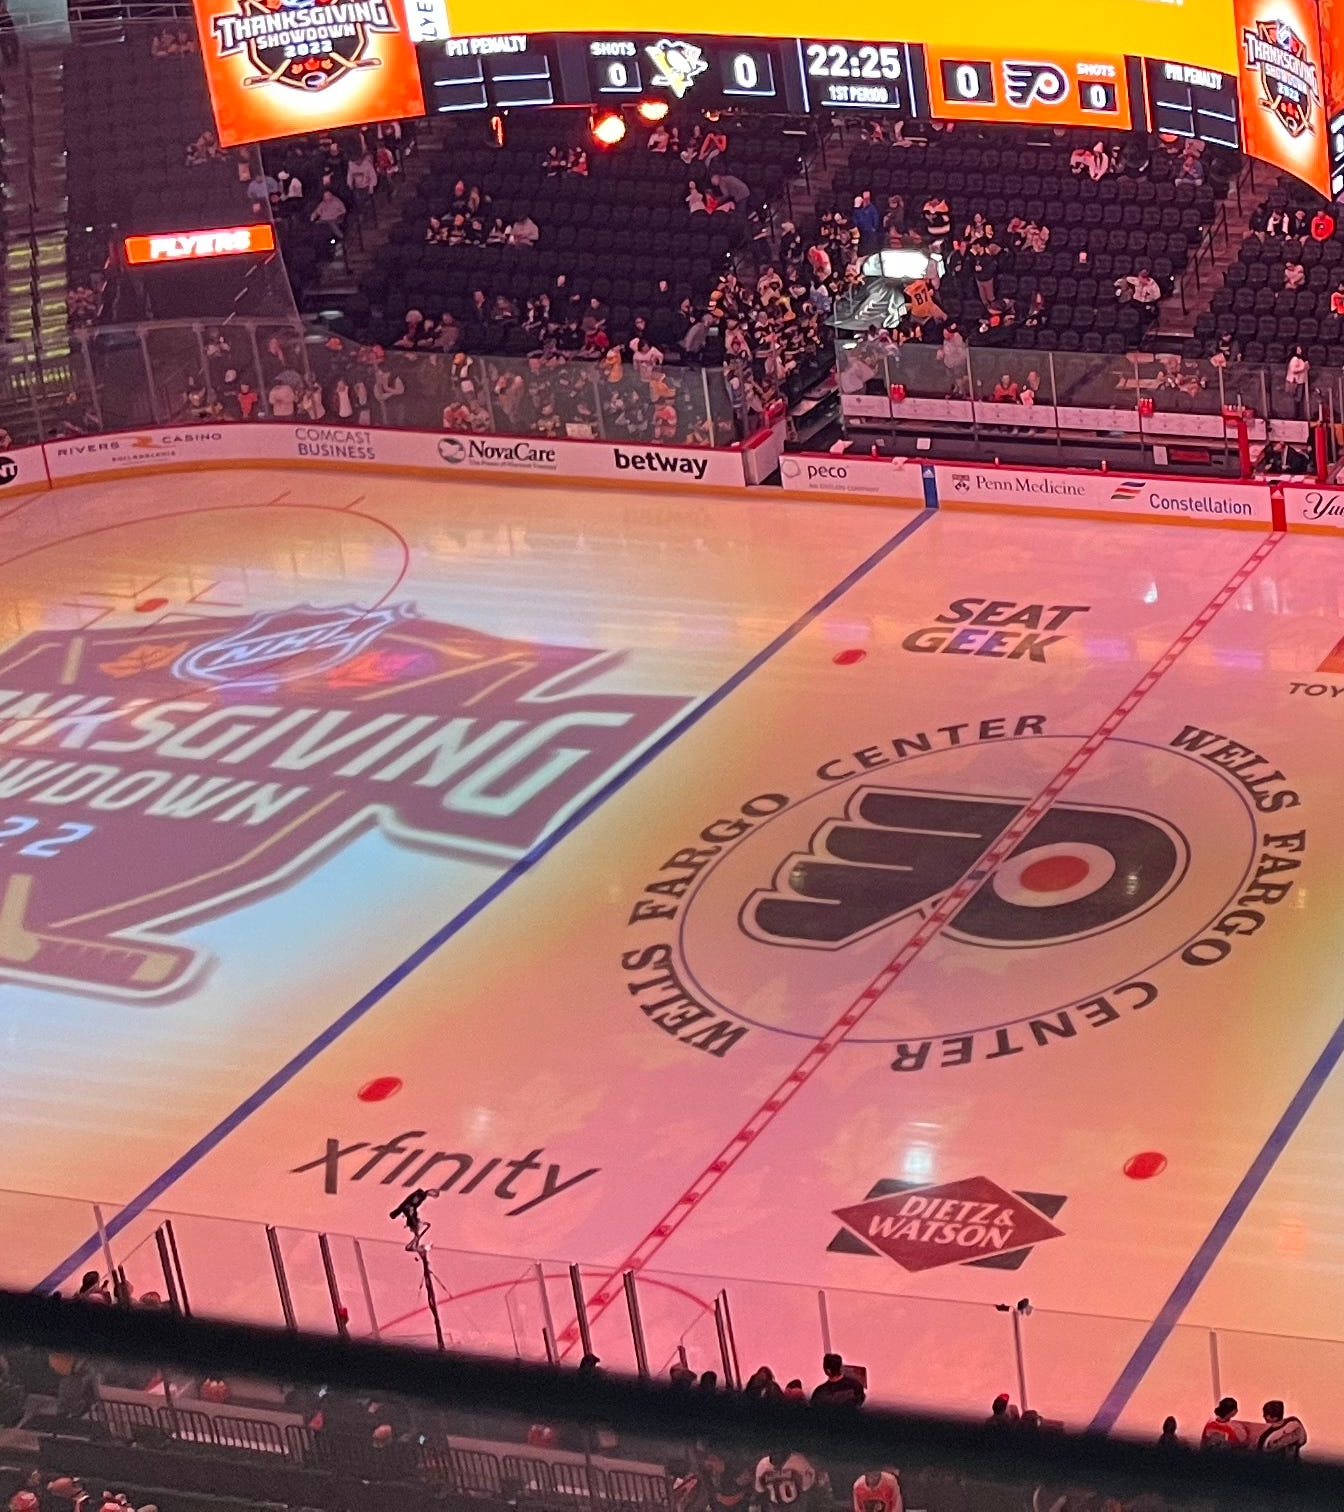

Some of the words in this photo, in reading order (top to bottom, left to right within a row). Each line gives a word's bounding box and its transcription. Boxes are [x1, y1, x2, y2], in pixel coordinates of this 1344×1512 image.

[257, 23, 356, 50] SHOWDOWN
[284, 38, 333, 58] 2022
[446, 39, 470, 57] PIT
[471, 35, 528, 55] PENALTY
[590, 42, 637, 57] SHOTS
[608, 63, 628, 87] 0
[732, 54, 758, 89] 0
[806, 44, 901, 79] 22:25
[1076, 62, 1116, 78] SHOTS
[1244, 31, 1319, 88] THANKSGIVING
[850, 85, 889, 104] PERIOD
[956, 64, 980, 99] 0
[1090, 83, 1107, 109] 0
[150, 229, 251, 260] FLYERS
[57, 440, 120, 457] RIVERS
[162, 431, 223, 445] CASINO
[294, 427, 371, 445] COMCAST
[297, 442, 376, 461] BUSINESS
[468, 439, 556, 463] NovaCare
[613, 448, 709, 481] betway
[807, 464, 848, 480] peco
[976, 474, 1012, 493] Penn
[1013, 476, 1086, 498] Medicine
[1148, 492, 1253, 517] Constellation
[933, 596, 1092, 631] SEAT
[900, 626, 1073, 664] GEEK
[0, 690, 634, 818] NKSGIVING
[816, 713, 1049, 783] CENTER
[1166, 725, 1301, 815] WELLS
[0, 757, 310, 827] WDOWN
[627, 791, 792, 926] FARGO
[1179, 829, 1309, 968] FARGO
[620, 945, 750, 1059] WELLS
[890, 980, 1159, 1074] CENTER
[291, 1129, 603, 1218] xfinity
[867, 1214, 1016, 1251] WATSON
